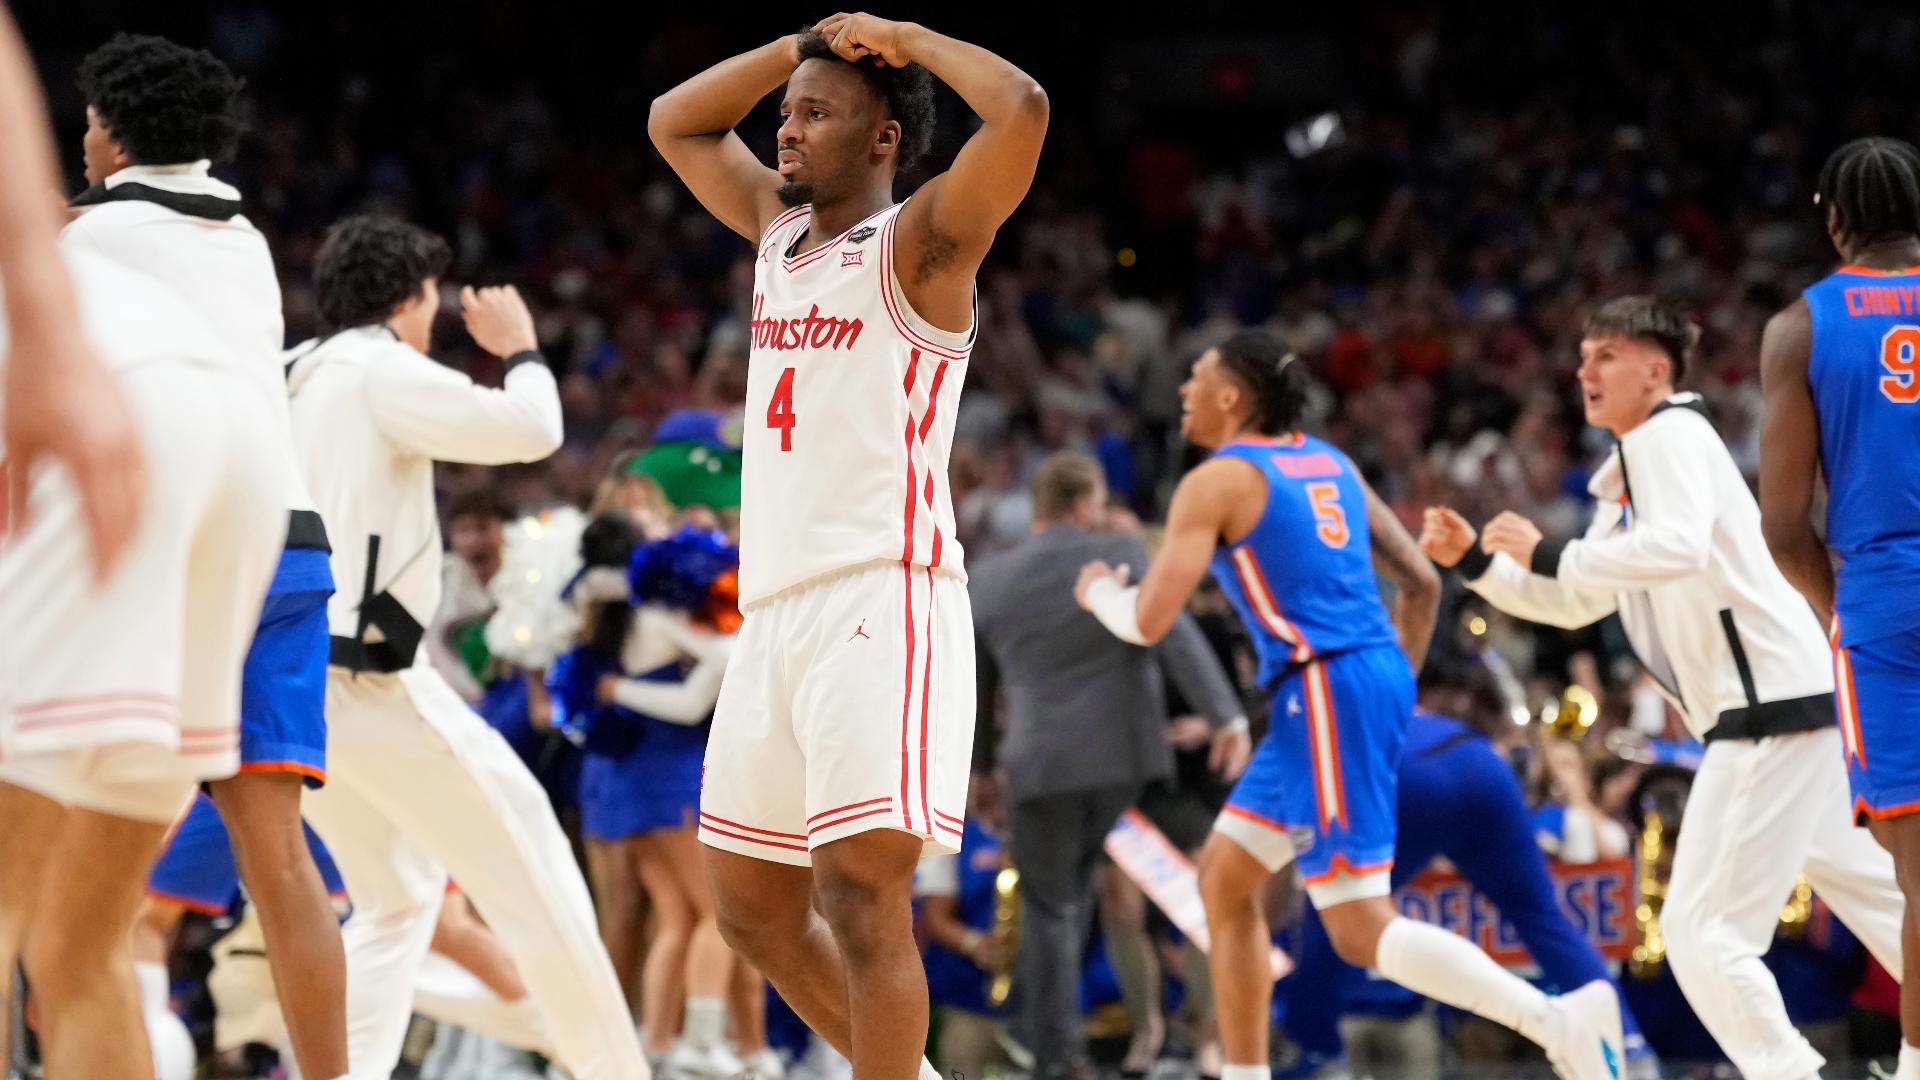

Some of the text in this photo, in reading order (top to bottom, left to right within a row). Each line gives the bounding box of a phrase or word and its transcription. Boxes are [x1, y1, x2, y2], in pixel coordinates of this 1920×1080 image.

[751, 292, 864, 351] Houston
[1880, 324, 1920, 404] 9
[767, 367, 796, 452] 4
[1305, 481, 1350, 549] 5
[1400, 876, 1622, 946] DEFSE
